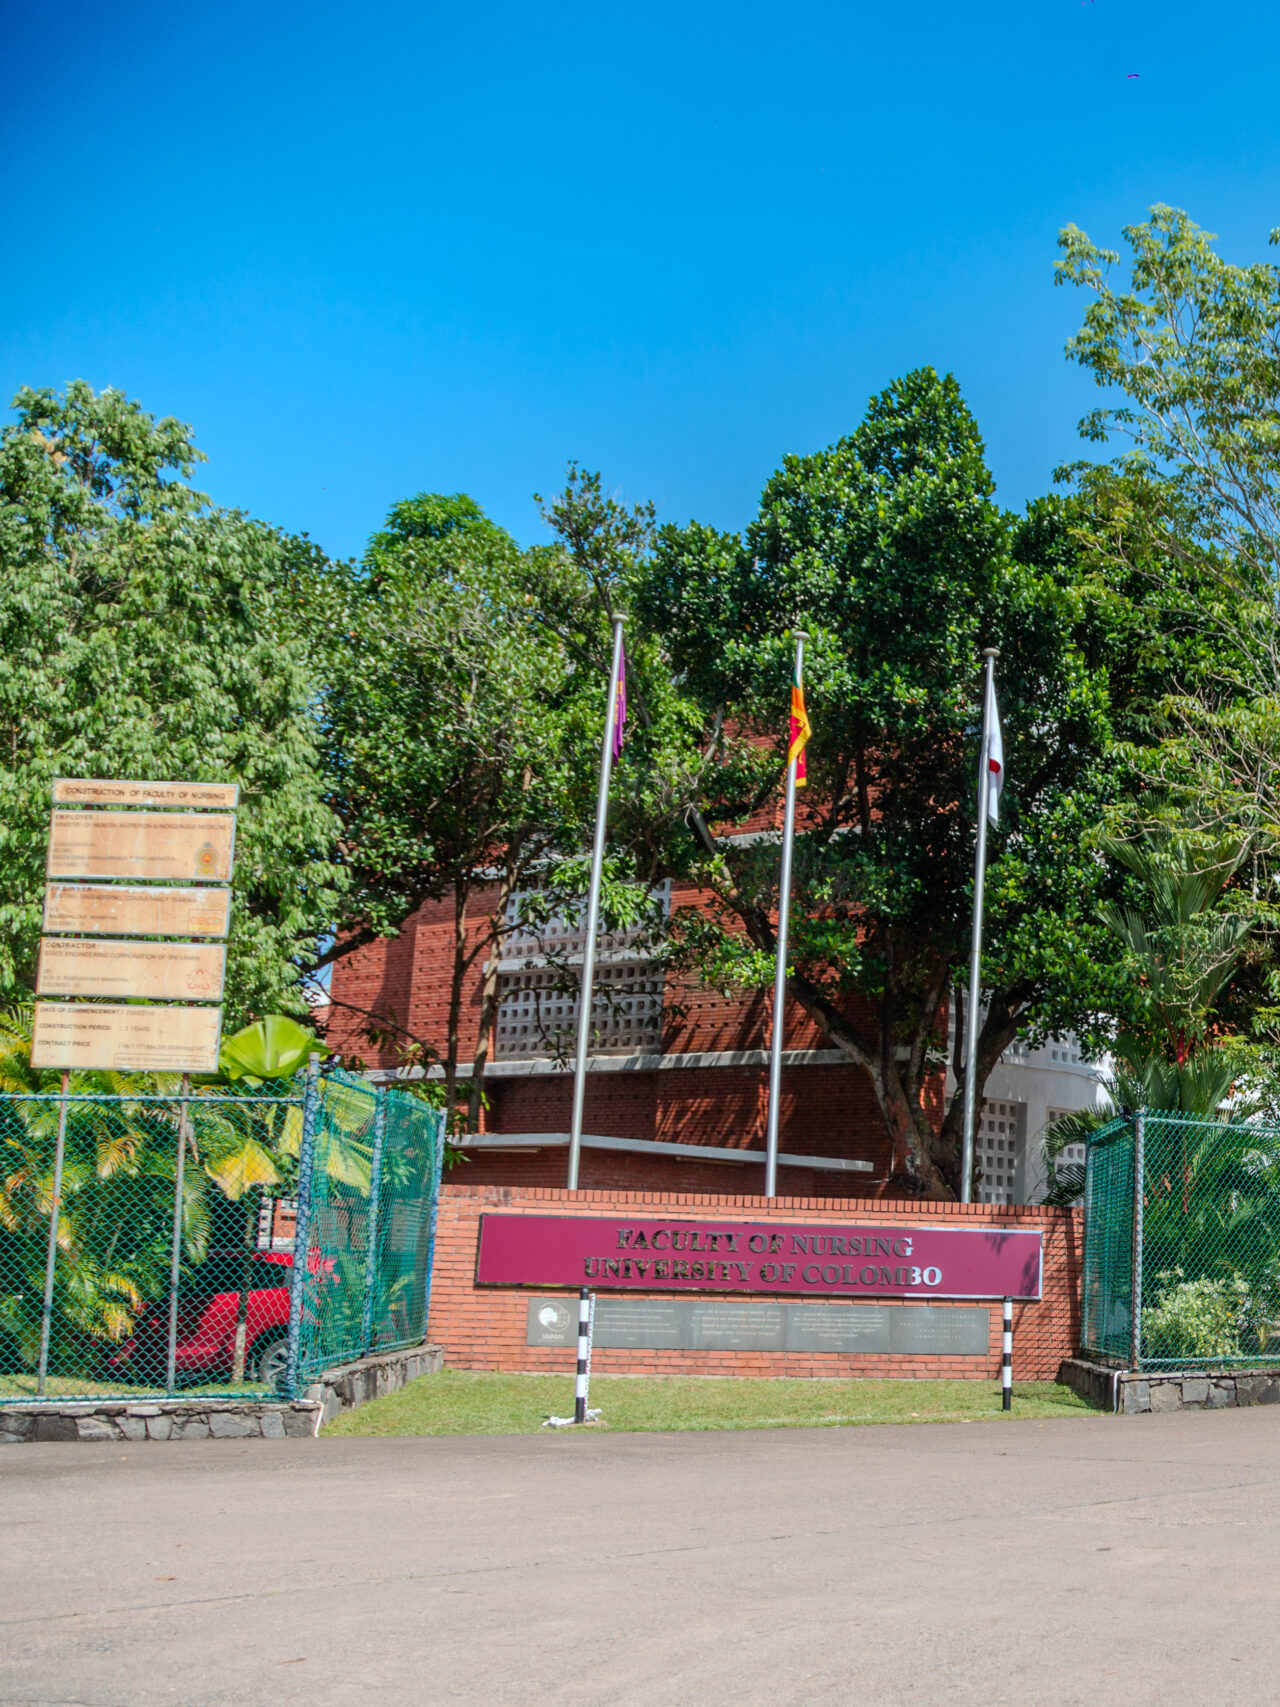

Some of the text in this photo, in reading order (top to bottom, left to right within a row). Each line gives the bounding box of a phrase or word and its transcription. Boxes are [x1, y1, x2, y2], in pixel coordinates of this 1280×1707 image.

[65, 787, 226, 799] CONSTRUCTION OF FACULTY OF NURSING
[616, 1228, 914, 1257] FACULTY OF NURSING
[584, 1257, 942, 1286] UNIVERSITY OF COLOMBO
